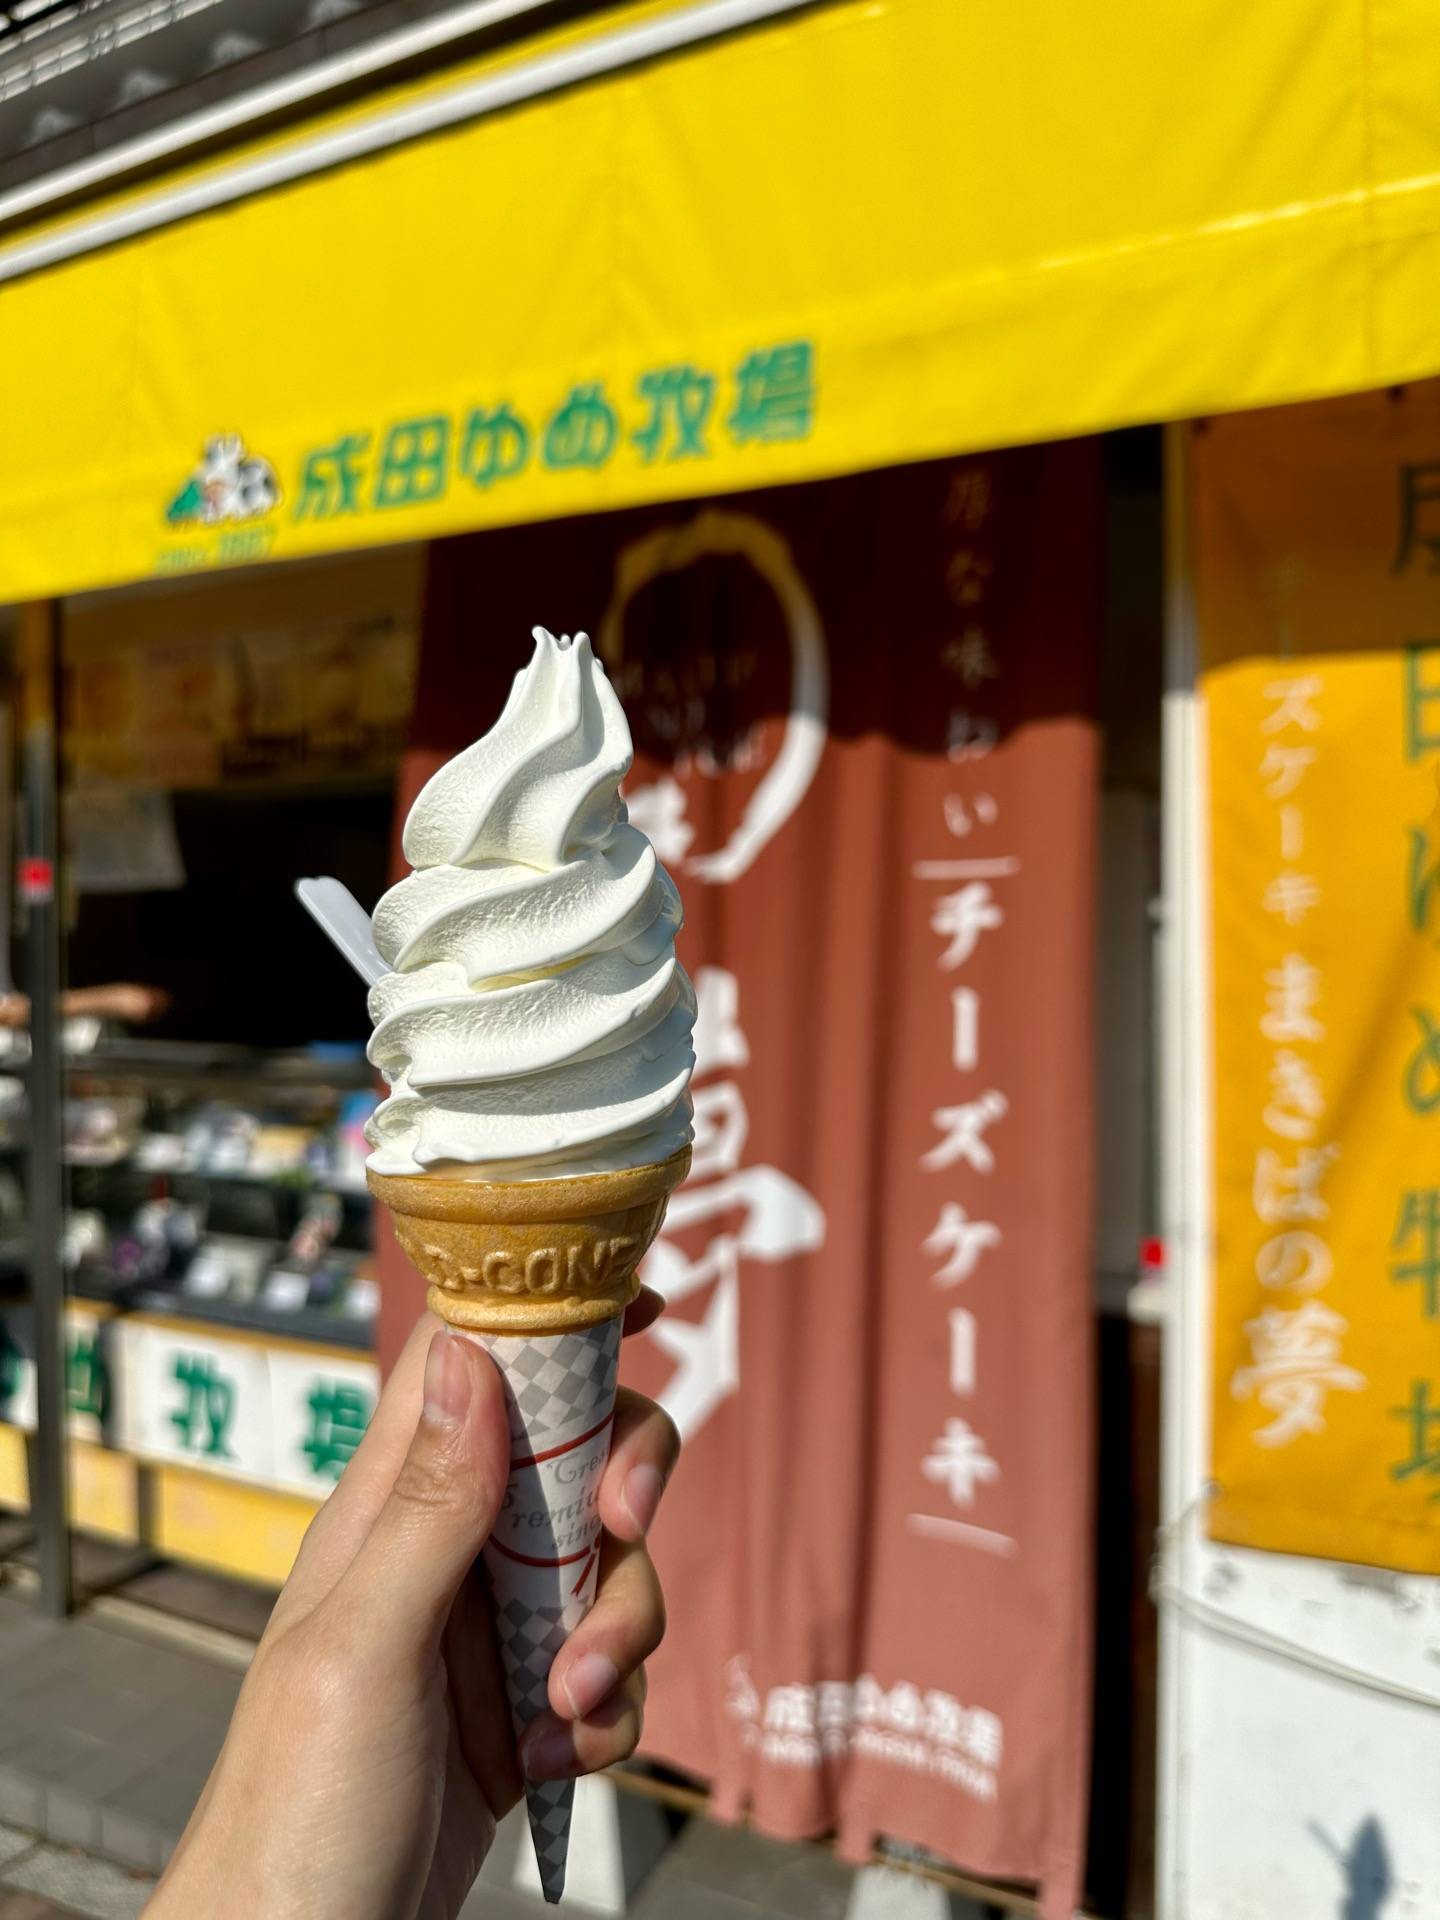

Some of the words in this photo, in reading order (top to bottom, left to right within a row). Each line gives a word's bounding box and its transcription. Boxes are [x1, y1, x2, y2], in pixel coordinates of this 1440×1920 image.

[296, 339, 817, 524] 成田ゆめ牧場
[920, 881, 1008, 1510] チーズケーキ
